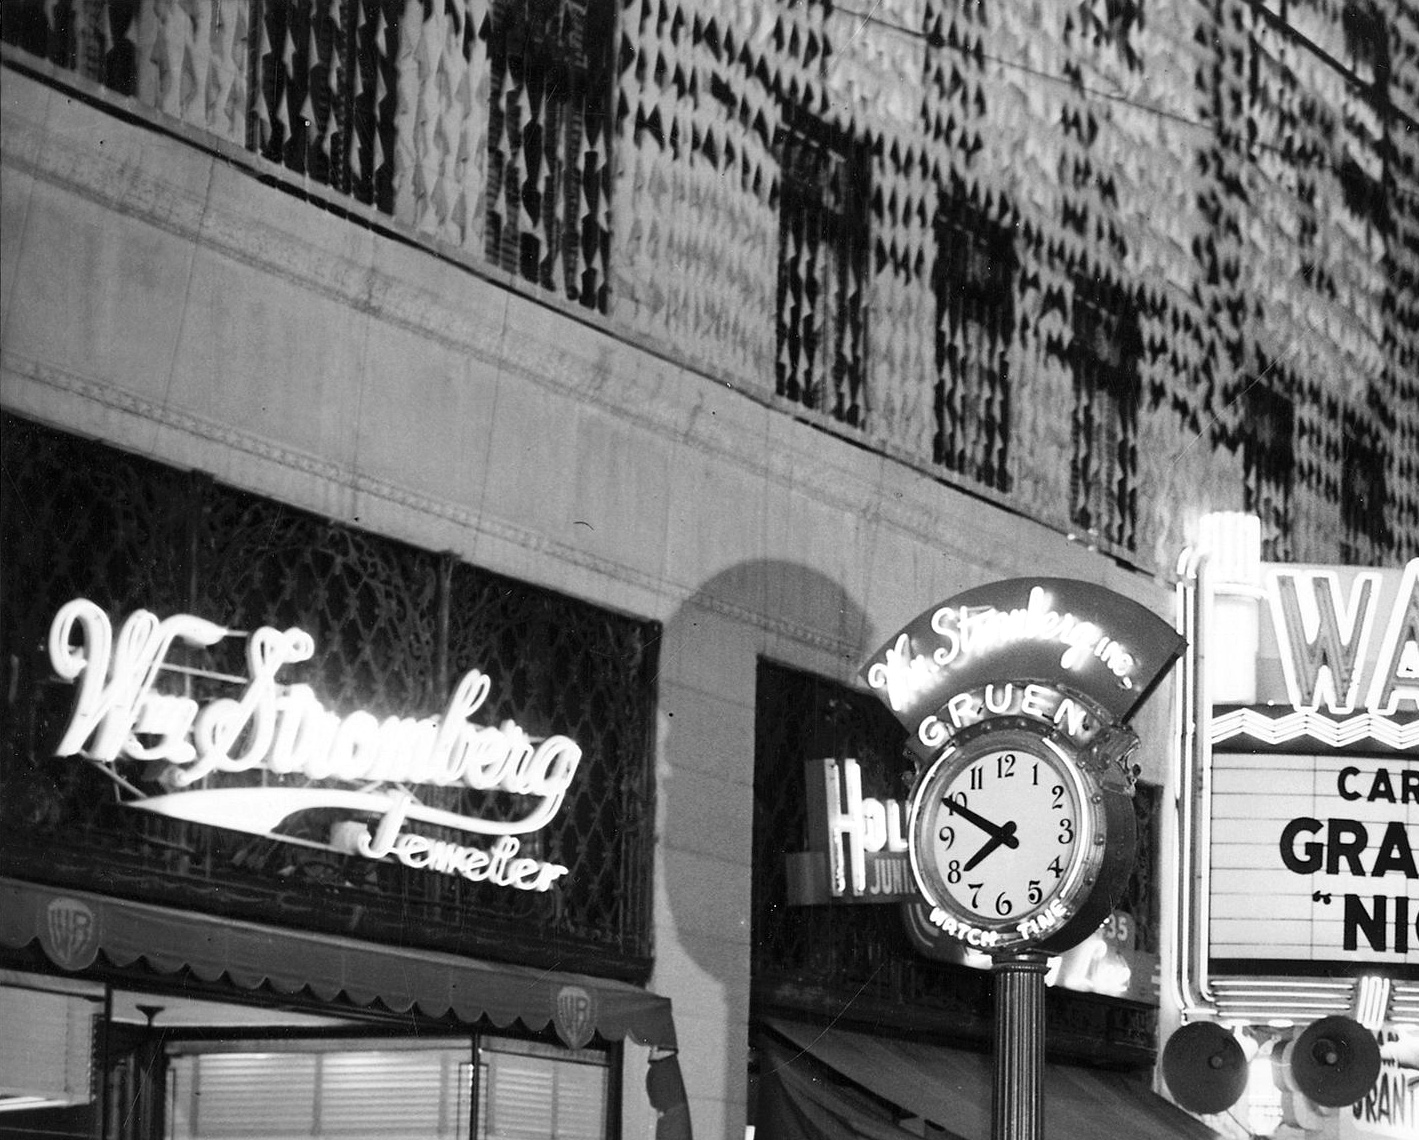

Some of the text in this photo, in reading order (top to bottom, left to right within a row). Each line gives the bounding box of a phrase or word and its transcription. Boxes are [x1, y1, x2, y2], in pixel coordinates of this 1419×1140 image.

[918, 682, 1087, 747] GRUEN
[174, 626, 583, 834] Stromberg
[970, 765, 984, 791] 11
[997, 754, 1016, 779] 12
[1032, 762, 1039, 786] 1
[1051, 785, 1065, 810] 2
[358, 794, 570, 892] Jeweler
[938, 825, 956, 852] 9
[1057, 818, 1074, 845] 3
[946, 859, 962, 885] 8
[1046, 854, 1065, 879] 4
[967, 882, 985, 909] 7
[995, 891, 1013, 916] 6
[1027, 880, 1043, 905] 5
[929, 907, 1000, 946] WATCH
